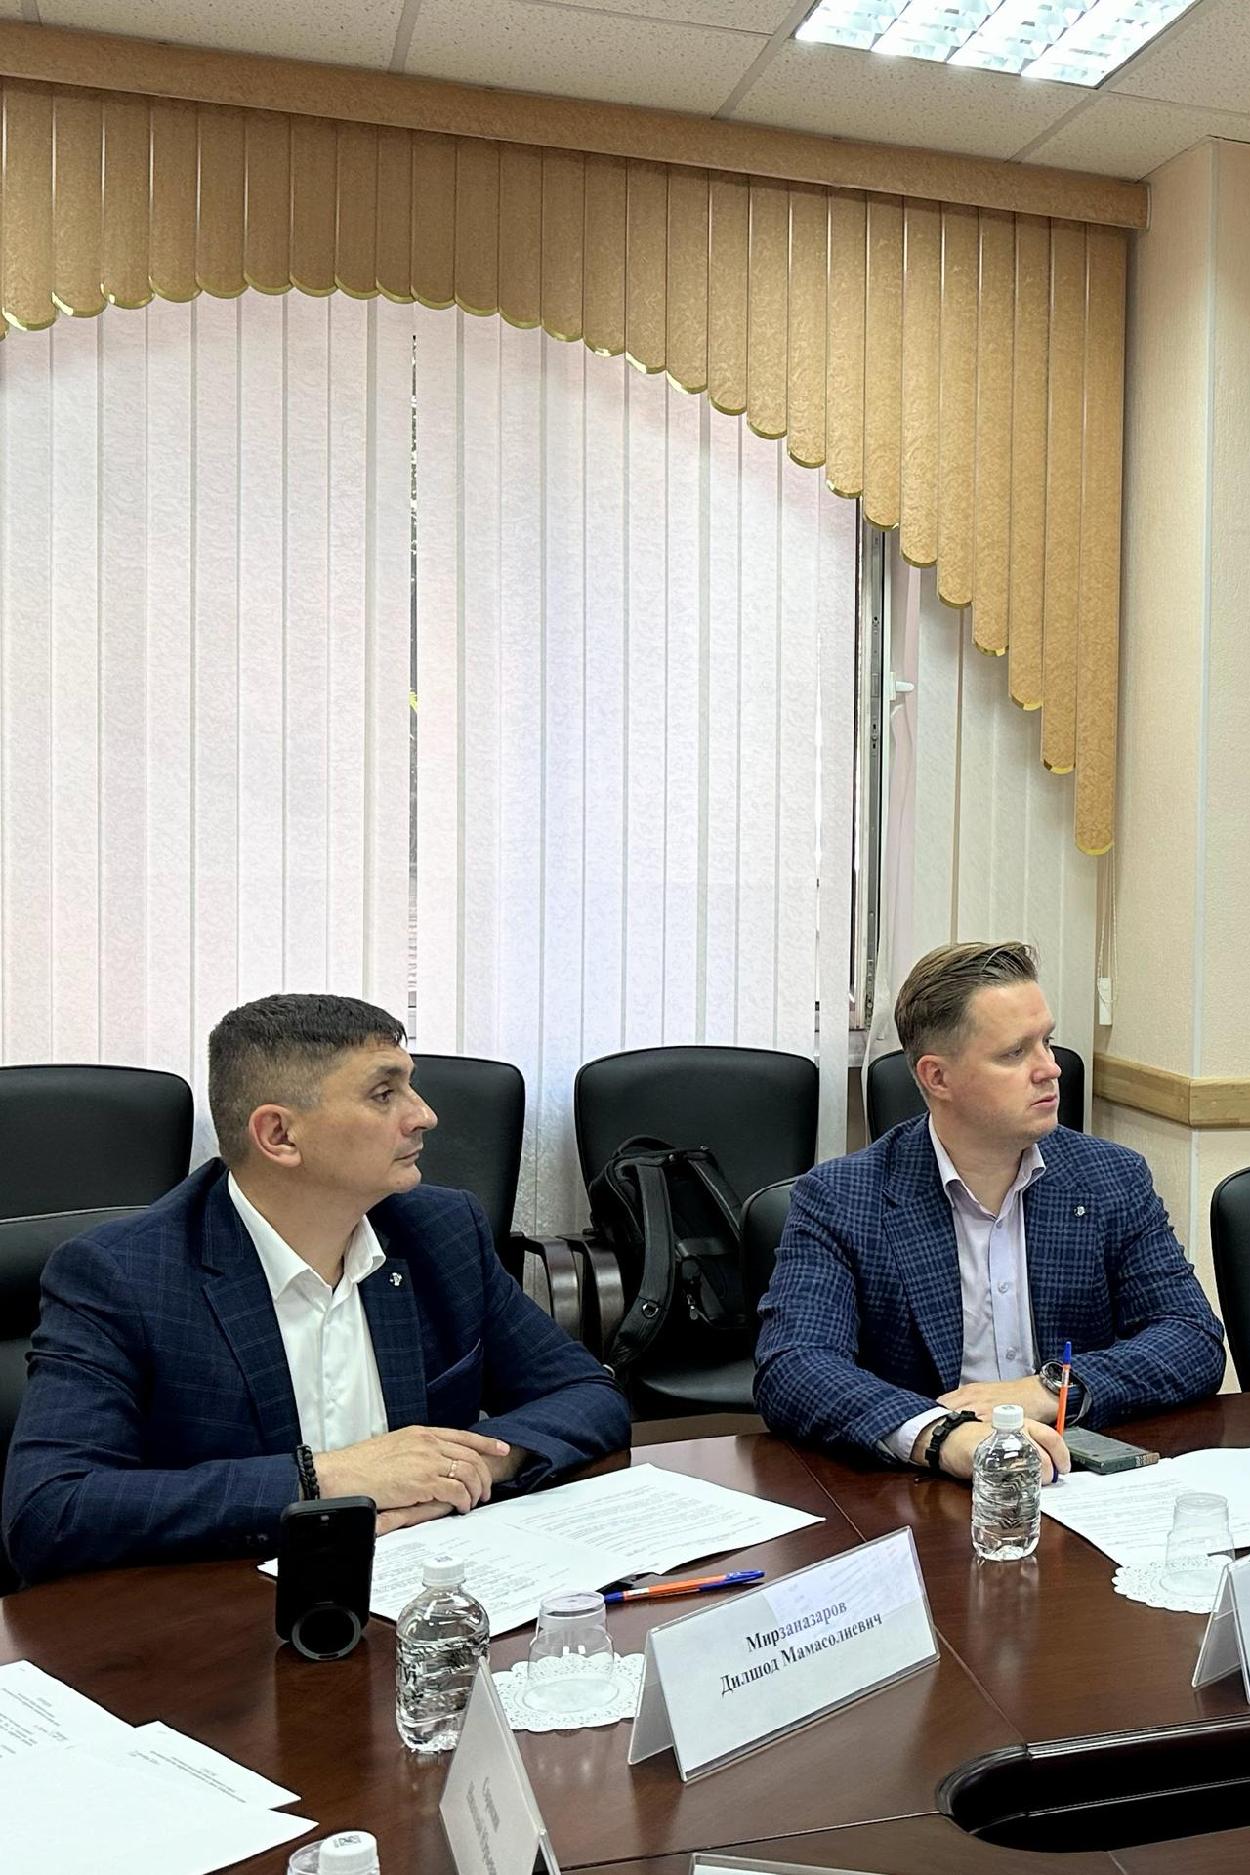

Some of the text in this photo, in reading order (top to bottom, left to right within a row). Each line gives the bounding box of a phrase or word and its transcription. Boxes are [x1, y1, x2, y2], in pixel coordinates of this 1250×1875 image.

[720, 1613, 883, 1698] Дилшод Мамасолиевич
[746, 1602, 847, 1652] Мирзаназаров
